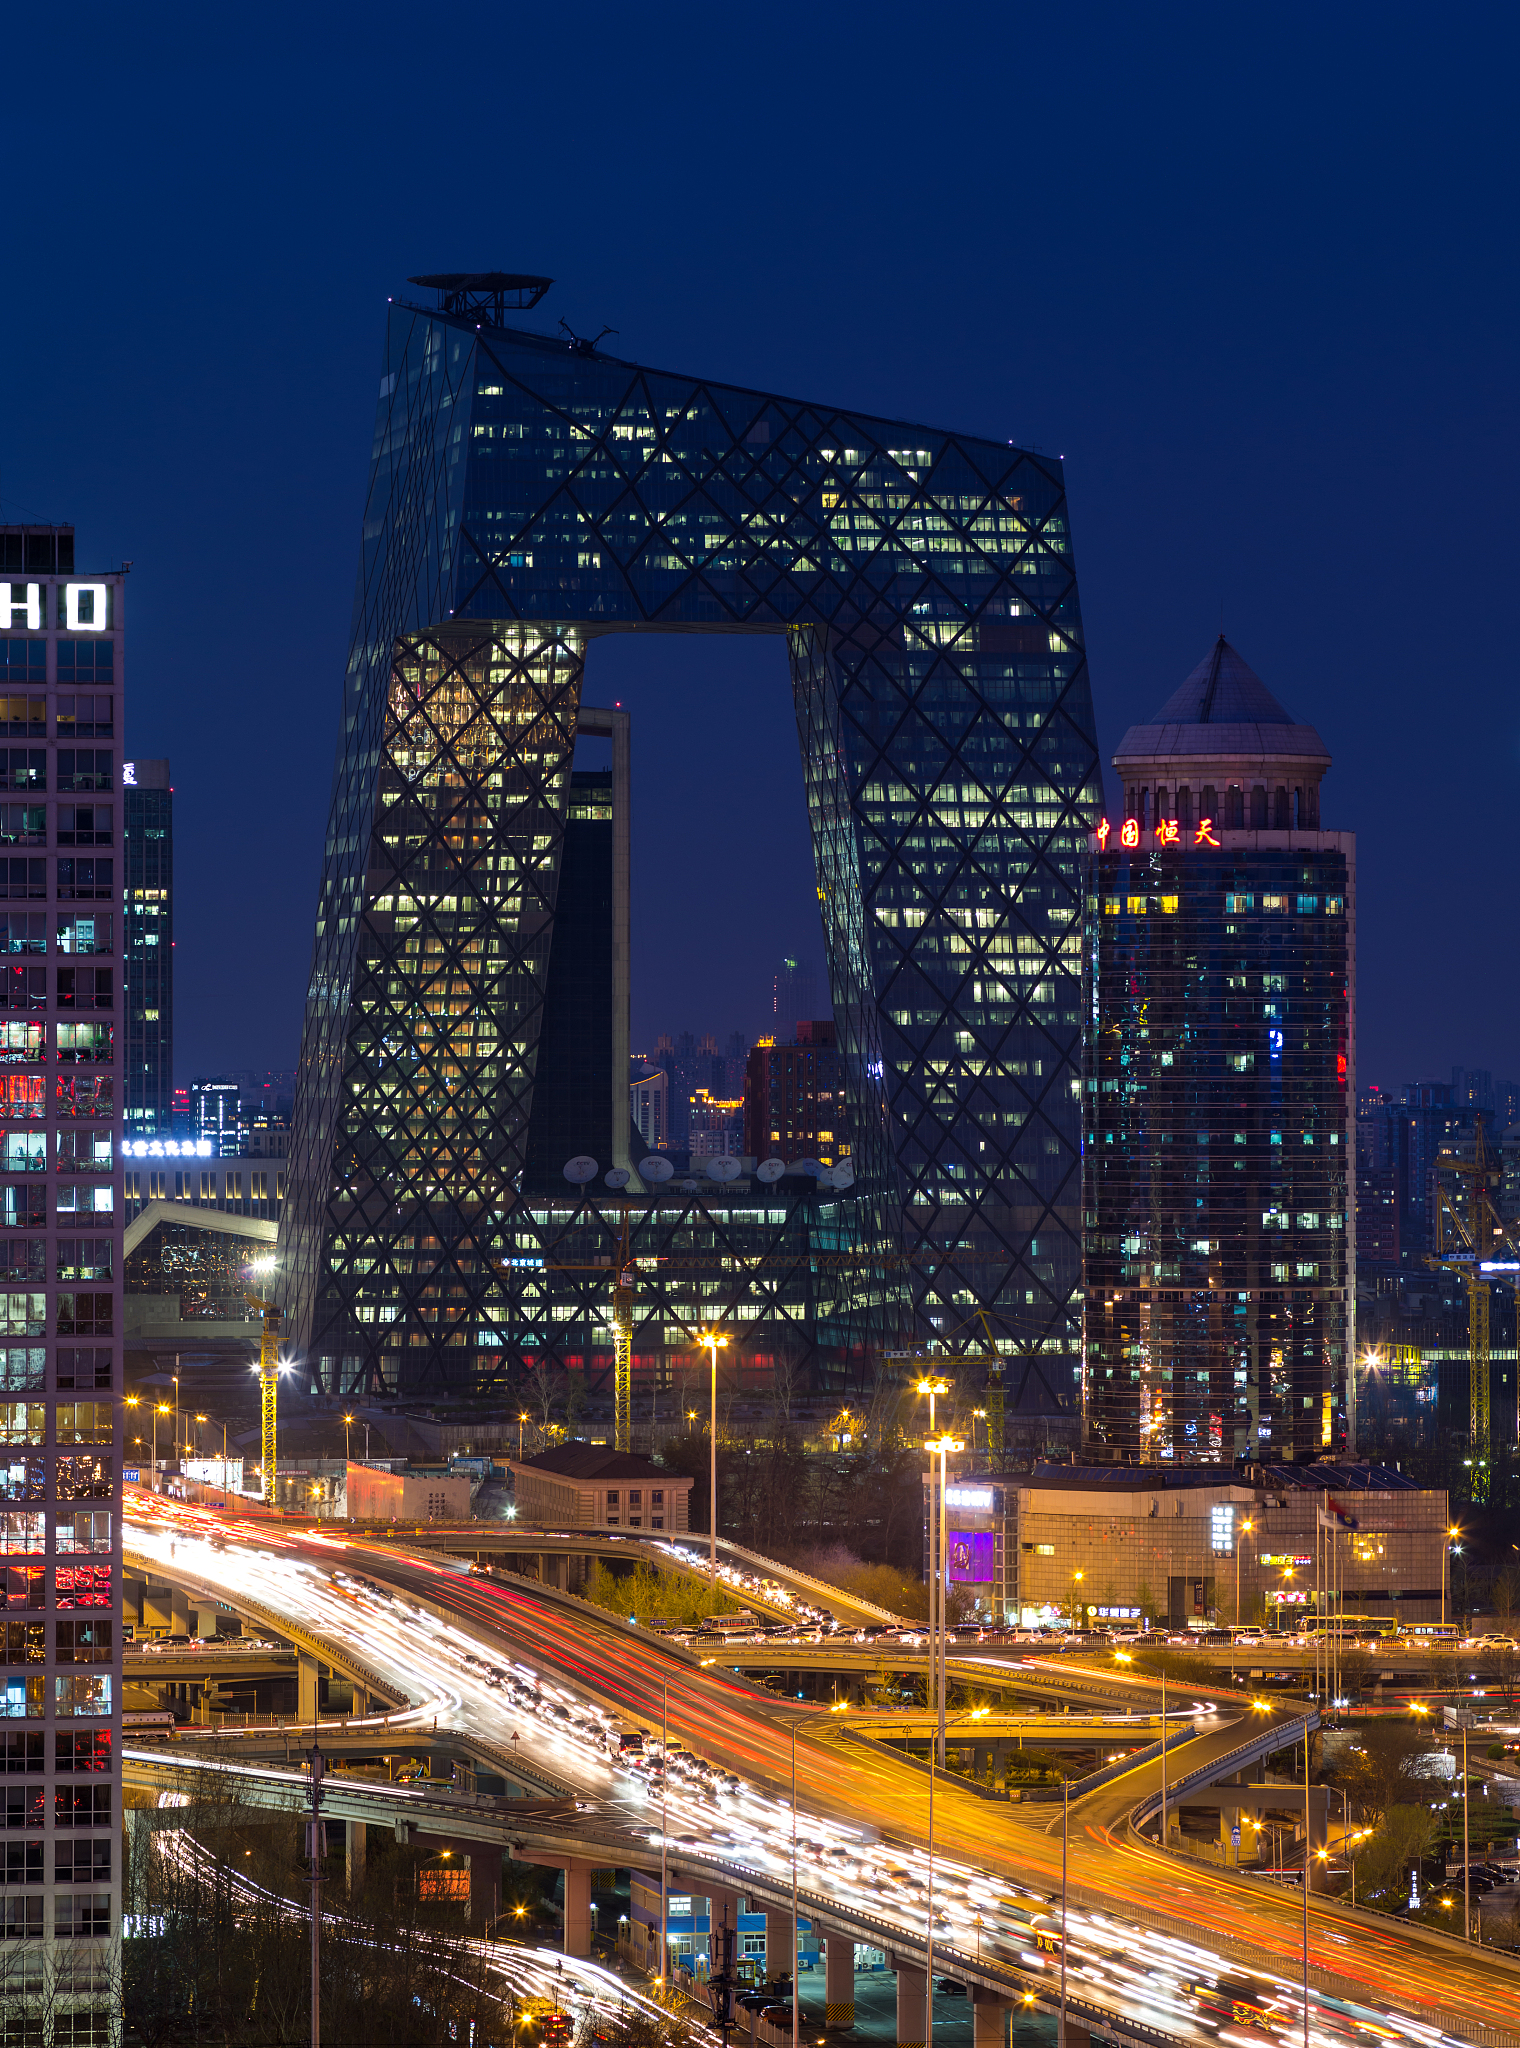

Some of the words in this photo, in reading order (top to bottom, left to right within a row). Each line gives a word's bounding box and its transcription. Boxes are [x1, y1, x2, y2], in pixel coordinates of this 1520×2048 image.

[1096, 817, 1221, 851] 中国恒天
[511, 1258, 544, 1267] 北京城建
